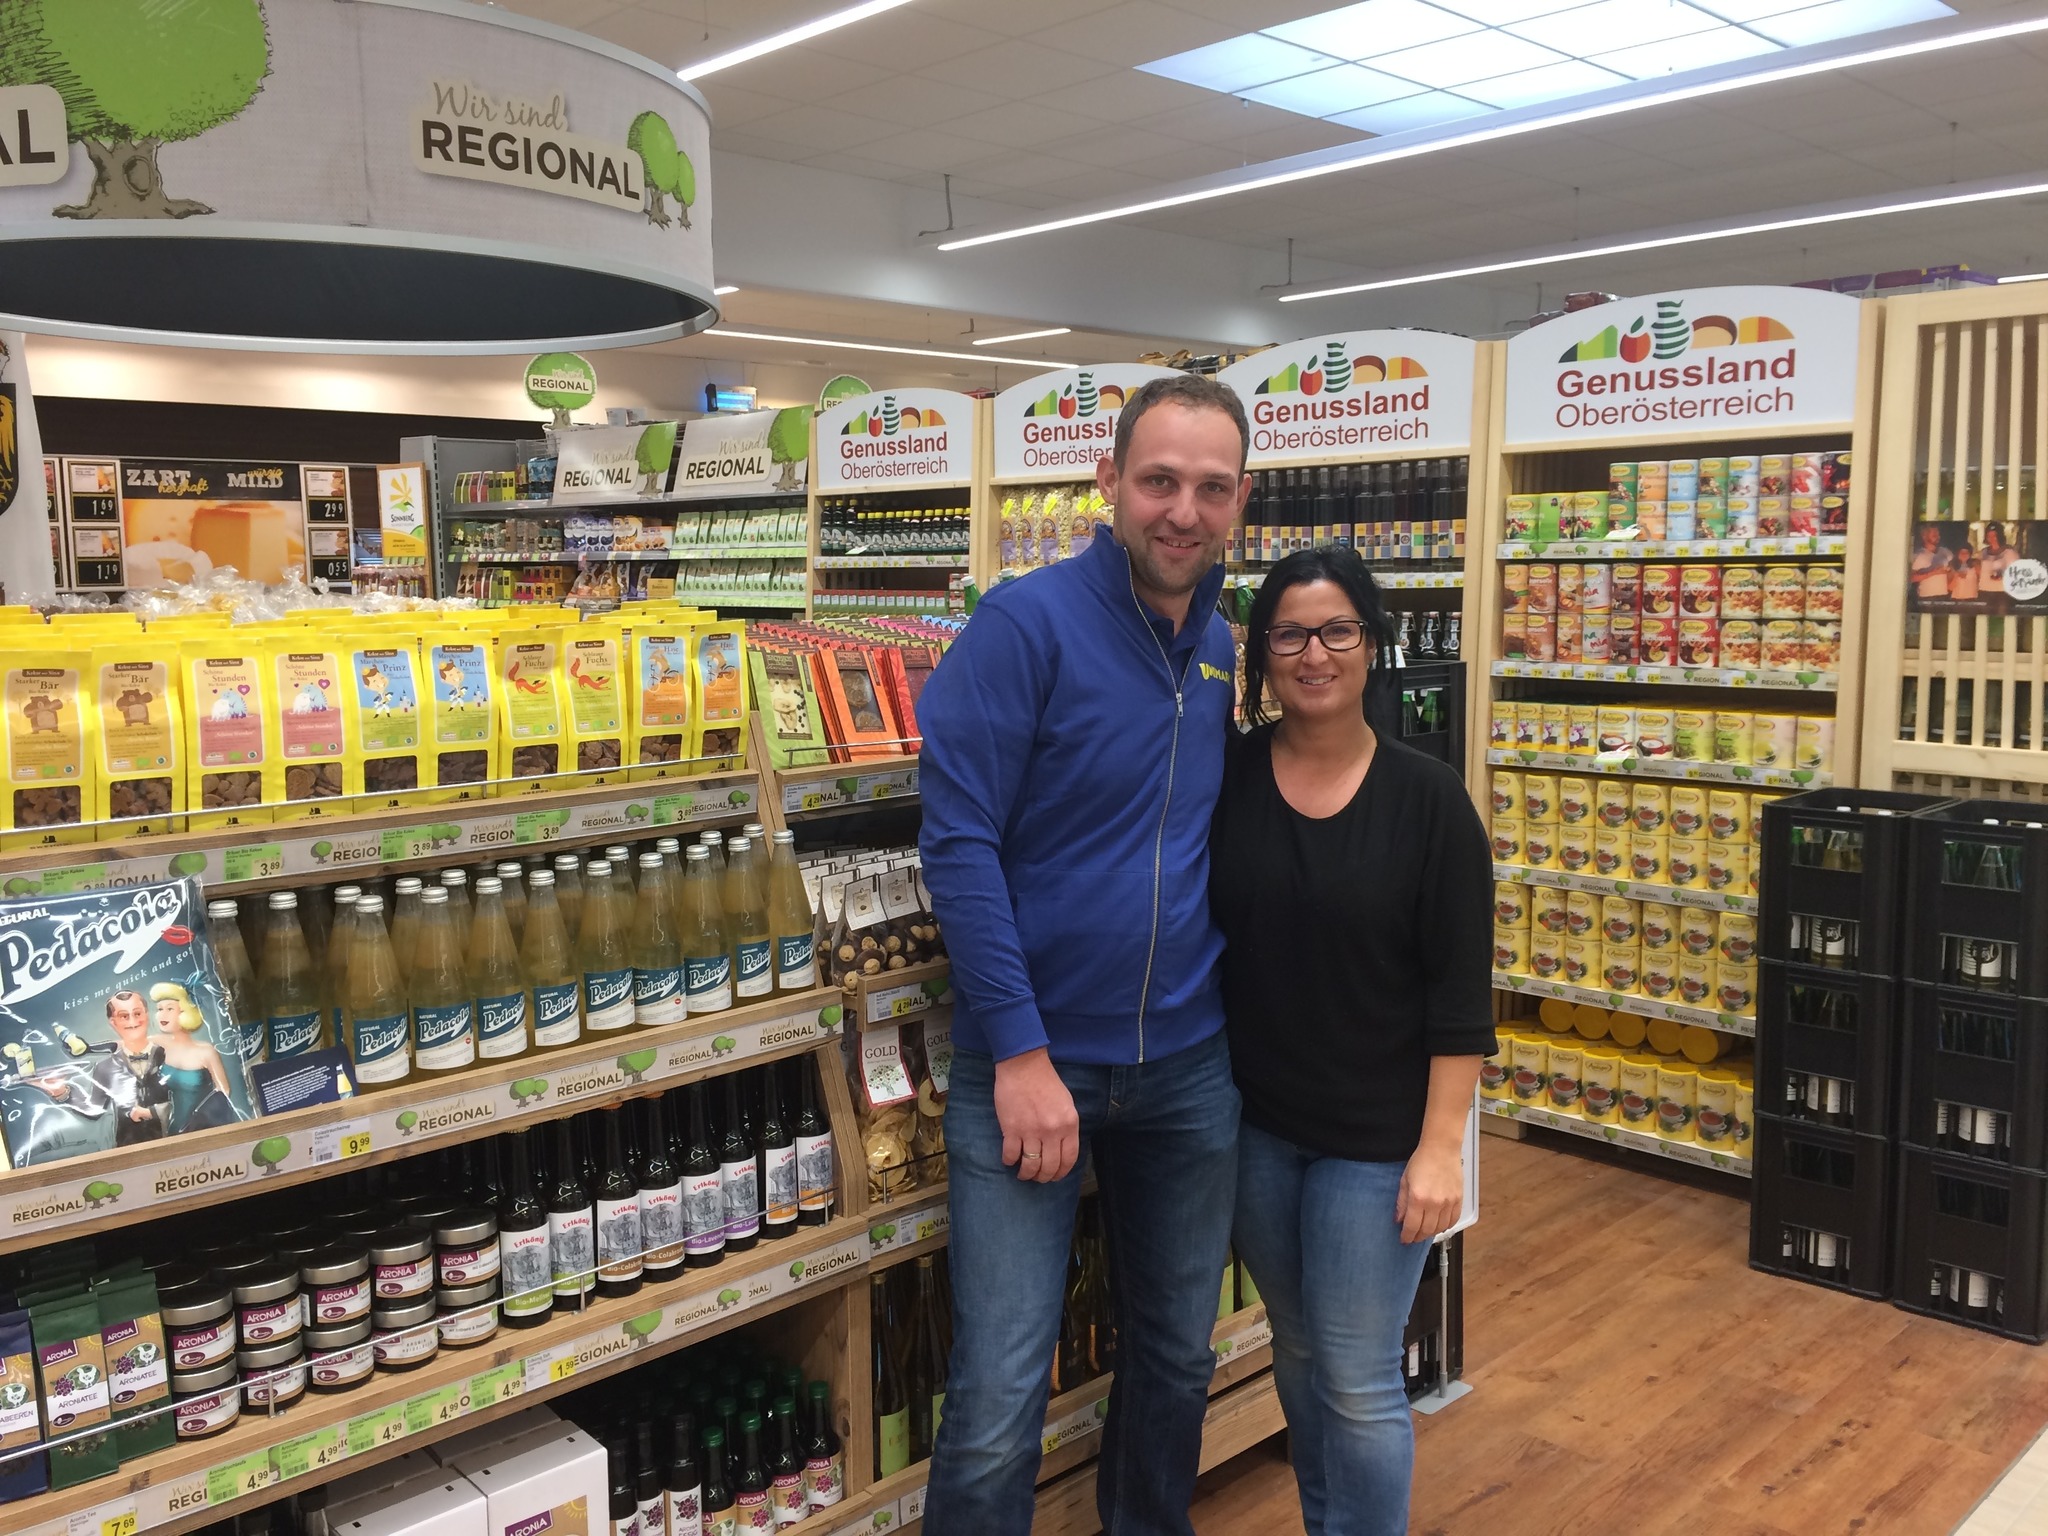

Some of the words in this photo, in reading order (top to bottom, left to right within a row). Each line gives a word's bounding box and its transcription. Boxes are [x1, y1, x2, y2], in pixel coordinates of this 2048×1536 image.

[433, 81, 498, 122] Wir
[504, 94, 564, 131] sind
[422, 119, 640, 201] REGIONAL
[1557, 349, 1796, 398] Genussland
[532, 378, 590, 392] REGIONAL
[1253, 385, 1430, 425] Genussland
[1556, 386, 1795, 429] Oberösterreich
[1023, 416, 1114, 444] Genussl
[1253, 418, 1430, 451] Oberösterreich
[841, 431, 948, 459] Genussland
[1024, 445, 1112, 467] Oberöster
[686, 456, 765, 480] REGIONAL
[841, 456, 948, 480] Oberösterreich
[126, 469, 191, 486] ZART
[227, 473, 284, 488] MILD
[563, 467, 632, 487] REGIONAL
[92, 499, 113, 516] 1.69
[324, 502, 343, 518] 2.99
[97, 564, 118, 580] 1.19
[328, 561, 347, 576] 0.55
[383, 664, 407, 672] Prinz
[459, 659, 481, 667] Prinz
[586, 656, 608, 664] Fuchs
[131, 674, 149, 684] Bär
[212, 674, 247, 682] Stunden
[294, 668, 327, 676] Stunden
[40, 681, 60, 690] Bär
[1762, 679, 1798, 687] REGIONAL
[582, 815, 624, 827] REGIONAL
[677, 808, 692, 821] 3.89
[470, 830, 515, 844] REGION
[543, 826, 559, 840] 3.89
[333, 846, 381, 862] REGIO
[413, 842, 431, 857] 3.89
[260, 861, 280, 876] 3.89
[1581, 884, 1611, 893] REGIONAL
[1681, 897, 1715, 907] REGIONAL
[0, 906, 50, 926] TURAL
[0, 889, 180, 996] Pedacola
[64, 994, 90, 1011] kiss
[94, 987, 111, 999] me
[115, 971, 148, 990] quick
[151, 957, 172, 972] and
[635, 970, 679, 997] Pedacola
[1575, 995, 1606, 1005] REGIONAL
[419, 1006, 469, 1041] Pedacola
[1675, 1013, 1709, 1024] REGIONAL
[275, 1015, 321, 1049] Pedacol
[759, 1024, 814, 1047] REGIONAL
[669, 1050, 711, 1067] REGIONAL
[865, 1045, 897, 1059] GOLD
[557, 1072, 622, 1098] REGIONAL
[419, 1105, 492, 1132] REGIONAL
[350, 1137, 370, 1154] 9.99
[155, 1164, 244, 1194] REGIONAL
[12, 1199, 83, 1223] REGIONAL
[443, 1254, 474, 1266] ARONIA
[805, 1251, 858, 1278] REGIONAL
[379, 1267, 412, 1279] ARONIA
[321, 1289, 355, 1303] ARONIA
[247, 1308, 282, 1323] ARONIA
[674, 1304, 717, 1326] REGIONAL
[107, 1328, 134, 1342] ARONIA
[177, 1332, 213, 1348] ARONIA
[1237, 1331, 1269, 1353] REGIONAL
[46, 1348, 73, 1362] ARONIA
[574, 1338, 628, 1365] EGIONAL
[557, 1360, 574, 1378] 1.59
[119, 1370, 157, 1386] ARONIATEE
[502, 1380, 520, 1397] 4.99
[58, 1393, 98, 1409] ARONIATEE
[180, 1400, 216, 1415] ARONIA
[0, 1410, 33, 1423] ABEEREN
[440, 1402, 458, 1420] 4.99
[383, 1423, 402, 1440] 4.99
[1057, 1419, 1091, 1440] EGIONAL
[317, 1446, 337, 1464] 4.99
[247, 1470, 269, 1490] 4.99
[168, 1488, 207, 1512] REGI
[739, 1493, 766, 1506] ARONIA
[111, 1517, 135, 1536] 7.69
